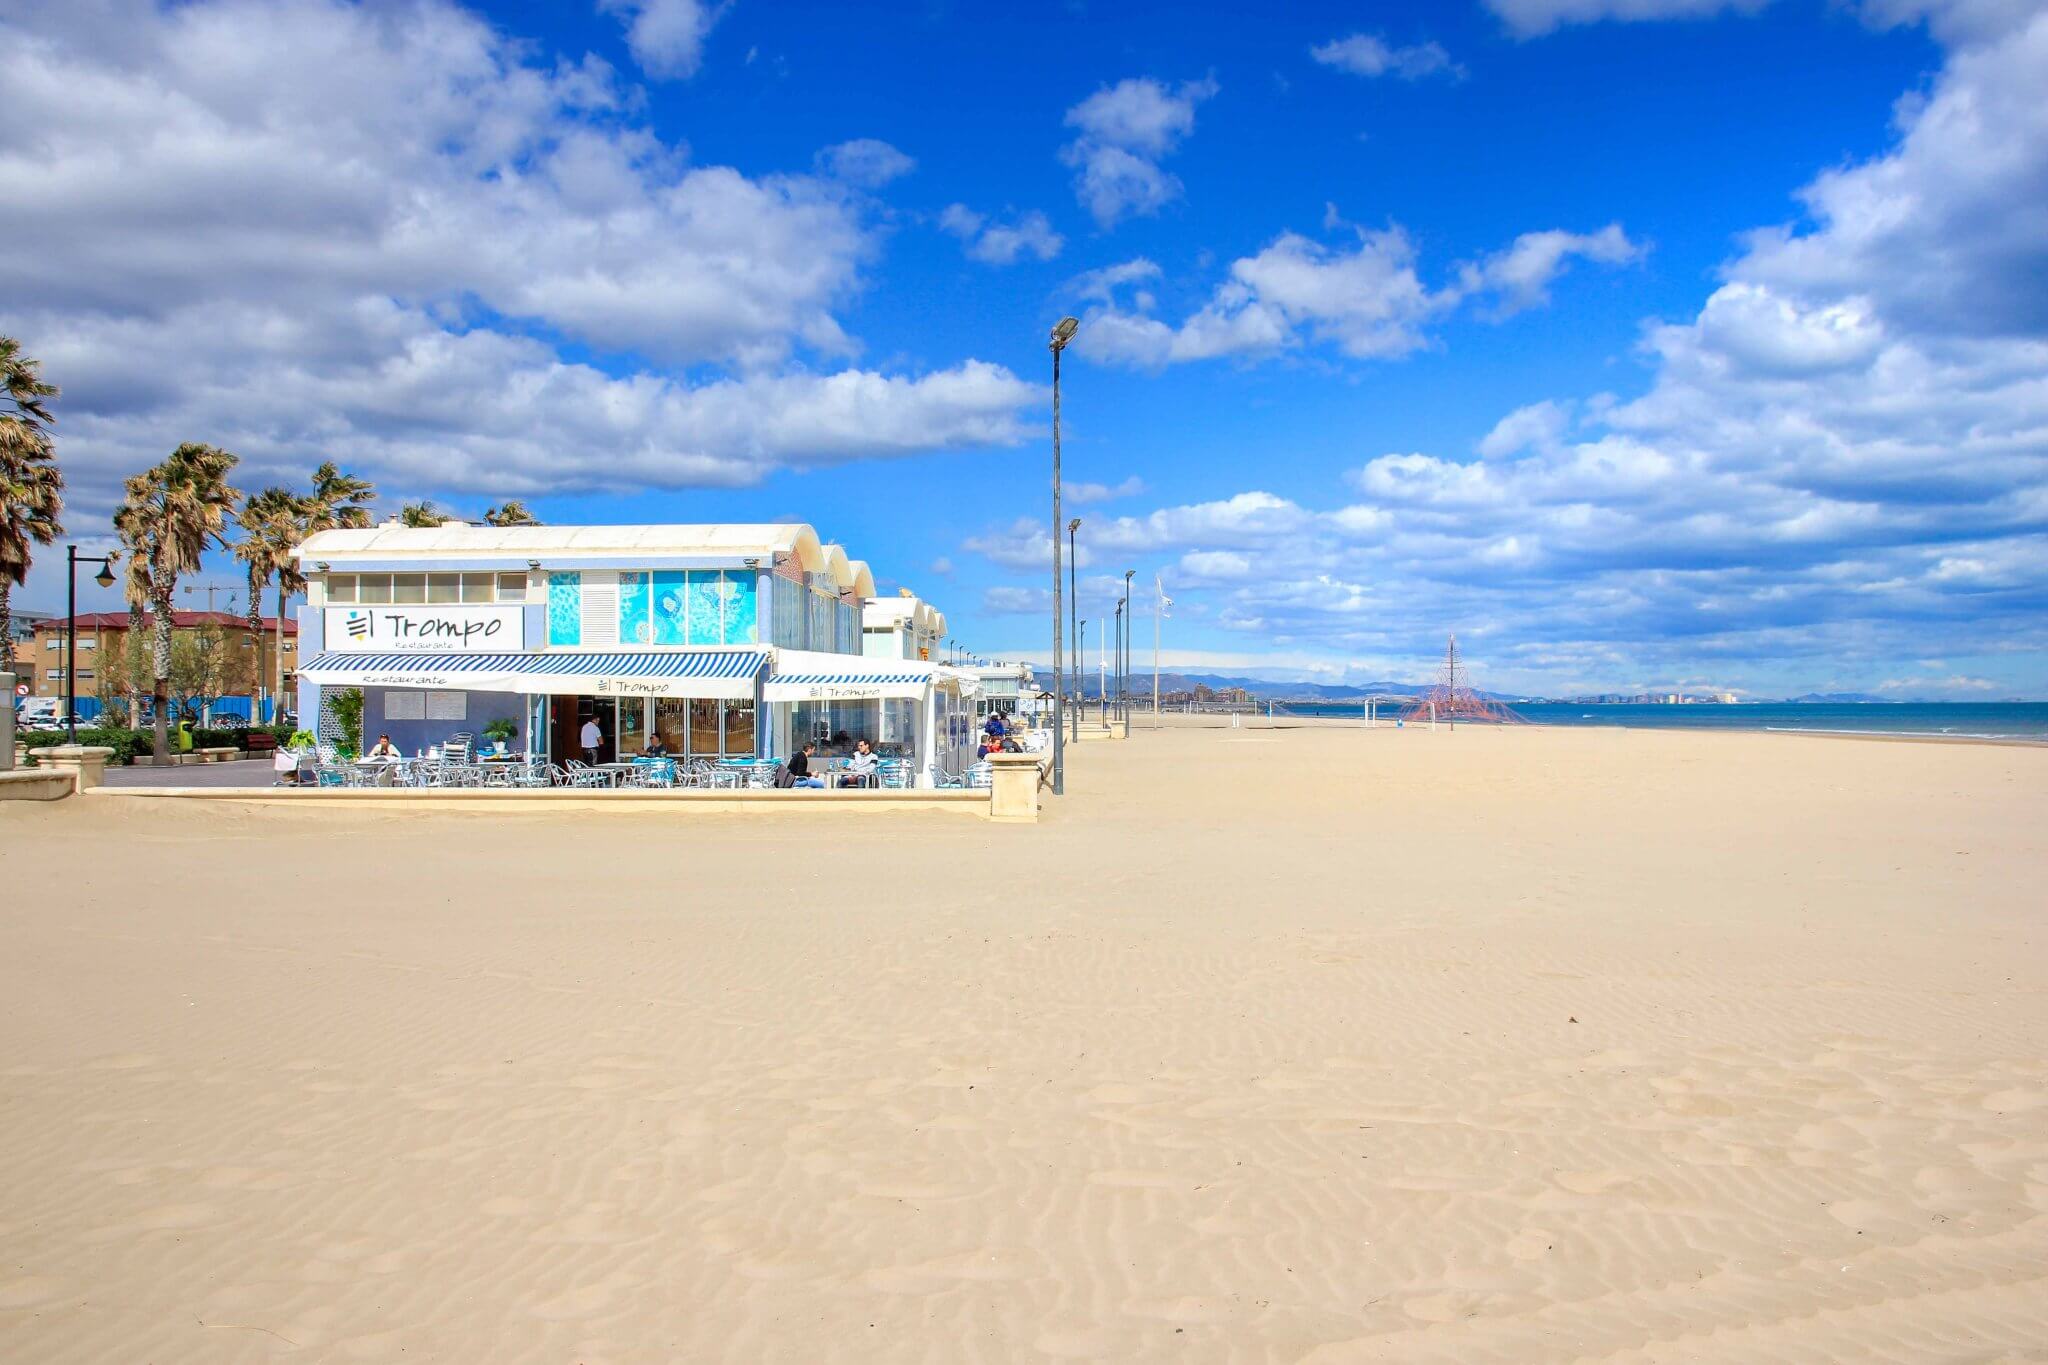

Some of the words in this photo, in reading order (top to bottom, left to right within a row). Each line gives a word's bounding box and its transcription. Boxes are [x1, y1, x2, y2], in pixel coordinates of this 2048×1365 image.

[346, 610, 374, 638] El
[385, 615, 502, 647] Trompo
[598, 678, 611, 691] El
[616, 681, 669, 696] Trompo
[809, 687, 823, 697] El
[828, 688, 880, 699] Trompo
